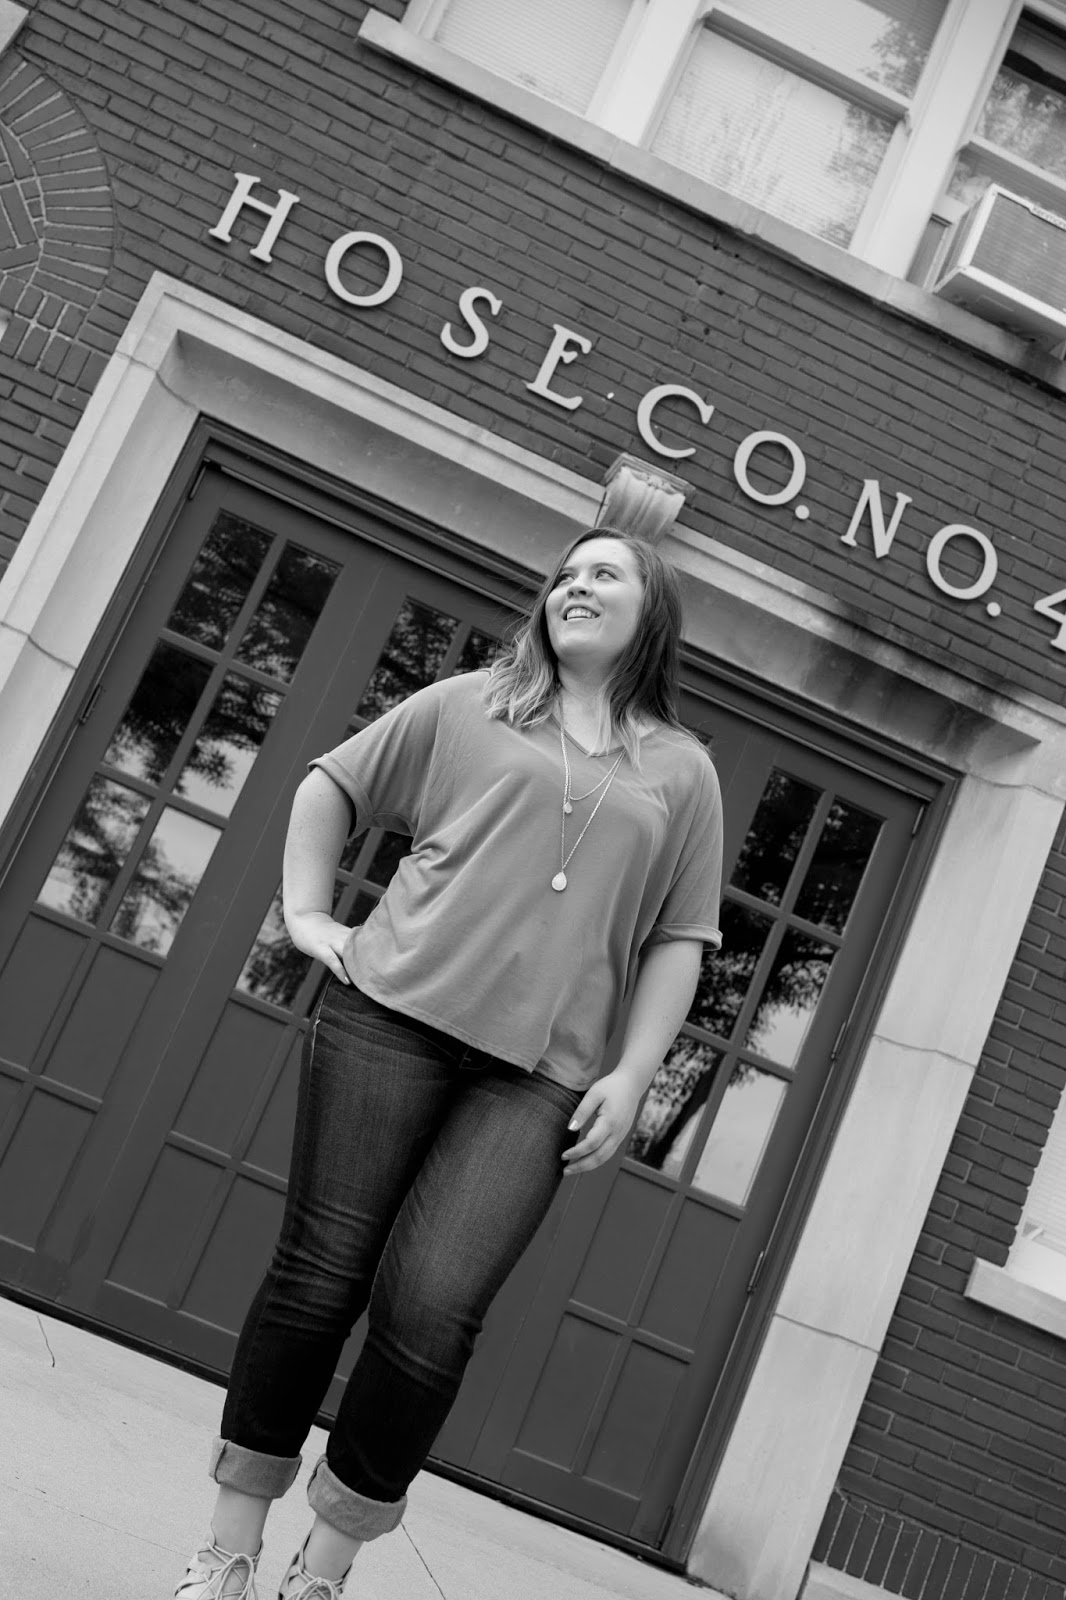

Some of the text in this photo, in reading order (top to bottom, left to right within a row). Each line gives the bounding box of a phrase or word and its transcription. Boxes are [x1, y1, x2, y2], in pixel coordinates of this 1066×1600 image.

[208, 171, 593, 410] HOSE
[637, 383, 810, 520] CO.
[840, 478, 1001, 617] NO.
